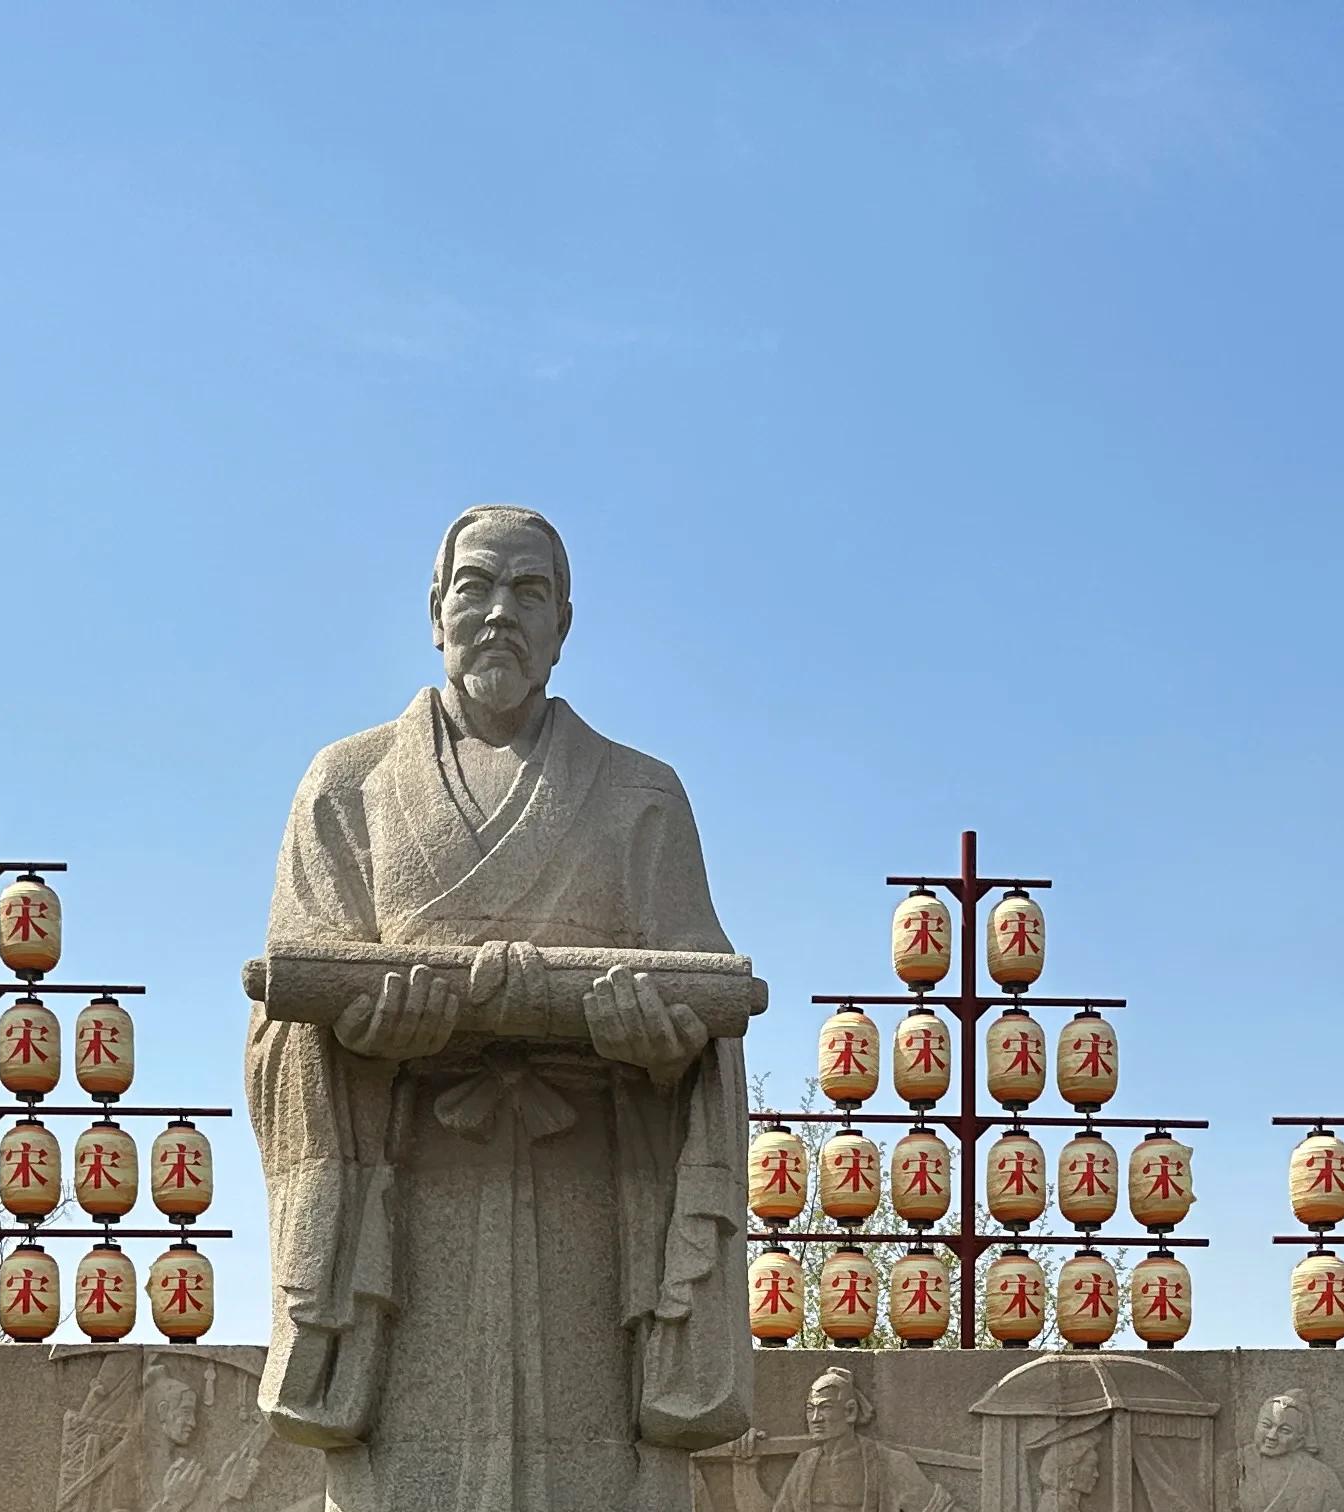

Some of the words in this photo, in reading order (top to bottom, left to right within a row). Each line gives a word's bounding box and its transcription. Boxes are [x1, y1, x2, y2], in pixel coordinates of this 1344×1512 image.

[4, 896, 49, 942] 宋
[904, 911, 944, 955] 宋
[1000, 912, 1041, 956] 宋
[6, 1018, 49, 1064] 宋
[78, 1019, 120, 1065] 宋
[828, 1031, 868, 1075] 宋
[905, 1029, 946, 1073] 宋
[1002, 1031, 1043, 1076] 宋
[1073, 1032, 1113, 1077] 宋
[6, 1142, 48, 1188] 宋
[79, 1143, 121, 1190] 宋
[160, 1143, 201, 1188] 宋
[761, 1150, 801, 1195] 宋
[835, 1148, 874, 1192] 宋
[902, 1151, 943, 1196] 宋
[999, 1151, 1040, 1196] 宋
[1068, 1153, 1110, 1197] 宋
[1142, 1155, 1183, 1200] 宋
[6, 1268, 49, 1314] 宋
[81, 1268, 123, 1314] 宋
[161, 1268, 204, 1314] 宋
[755, 1270, 795, 1315] 宋
[832, 1270, 872, 1314] 宋
[902, 1270, 942, 1315] 宋
[1000, 1273, 1041, 1318] 宋
[1074, 1273, 1113, 1318] 宋
[1141, 1276, 1183, 1320] 宋
